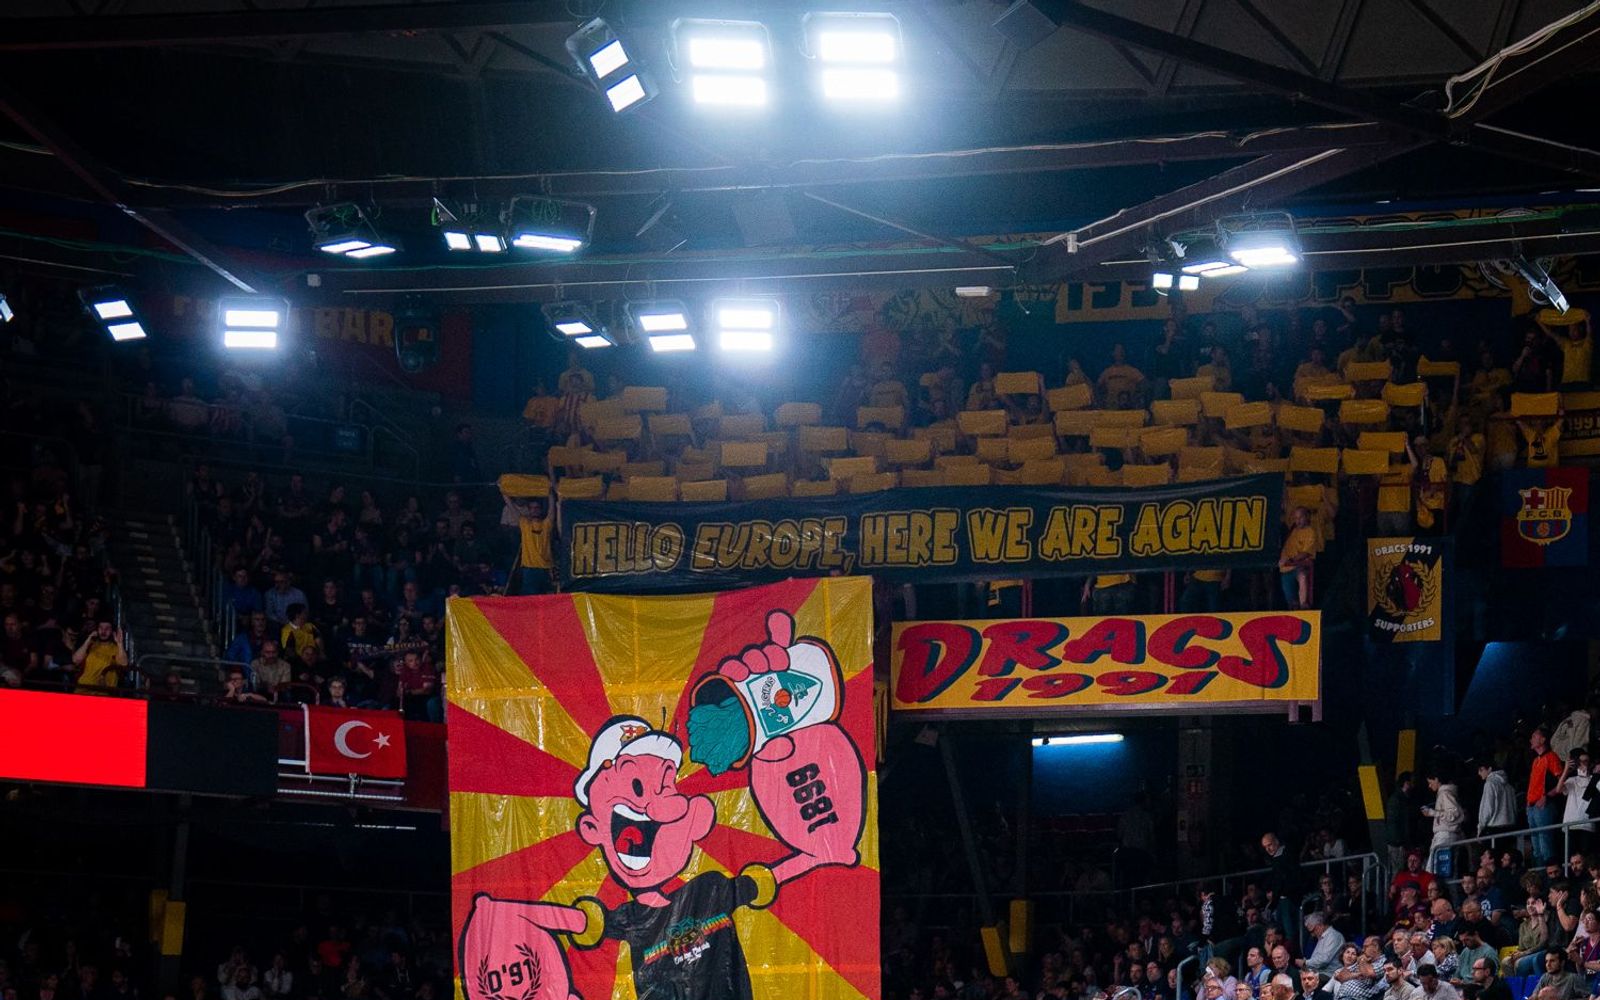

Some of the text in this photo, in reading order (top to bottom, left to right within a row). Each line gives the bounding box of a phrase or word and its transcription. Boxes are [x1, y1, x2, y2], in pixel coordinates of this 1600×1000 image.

[571, 496, 1268, 577] HELLO EUROPE, HERE WE ARE AGAIN
[1375, 543, 1432, 556] DRACS 1991
[1374, 617, 1435, 633] SUPPORTERS
[895, 614, 1311, 704] DRACS
[970, 670, 1220, 701] 1991
[785, 762, 840, 835] 1899
[488, 956, 533, 994] D'91
